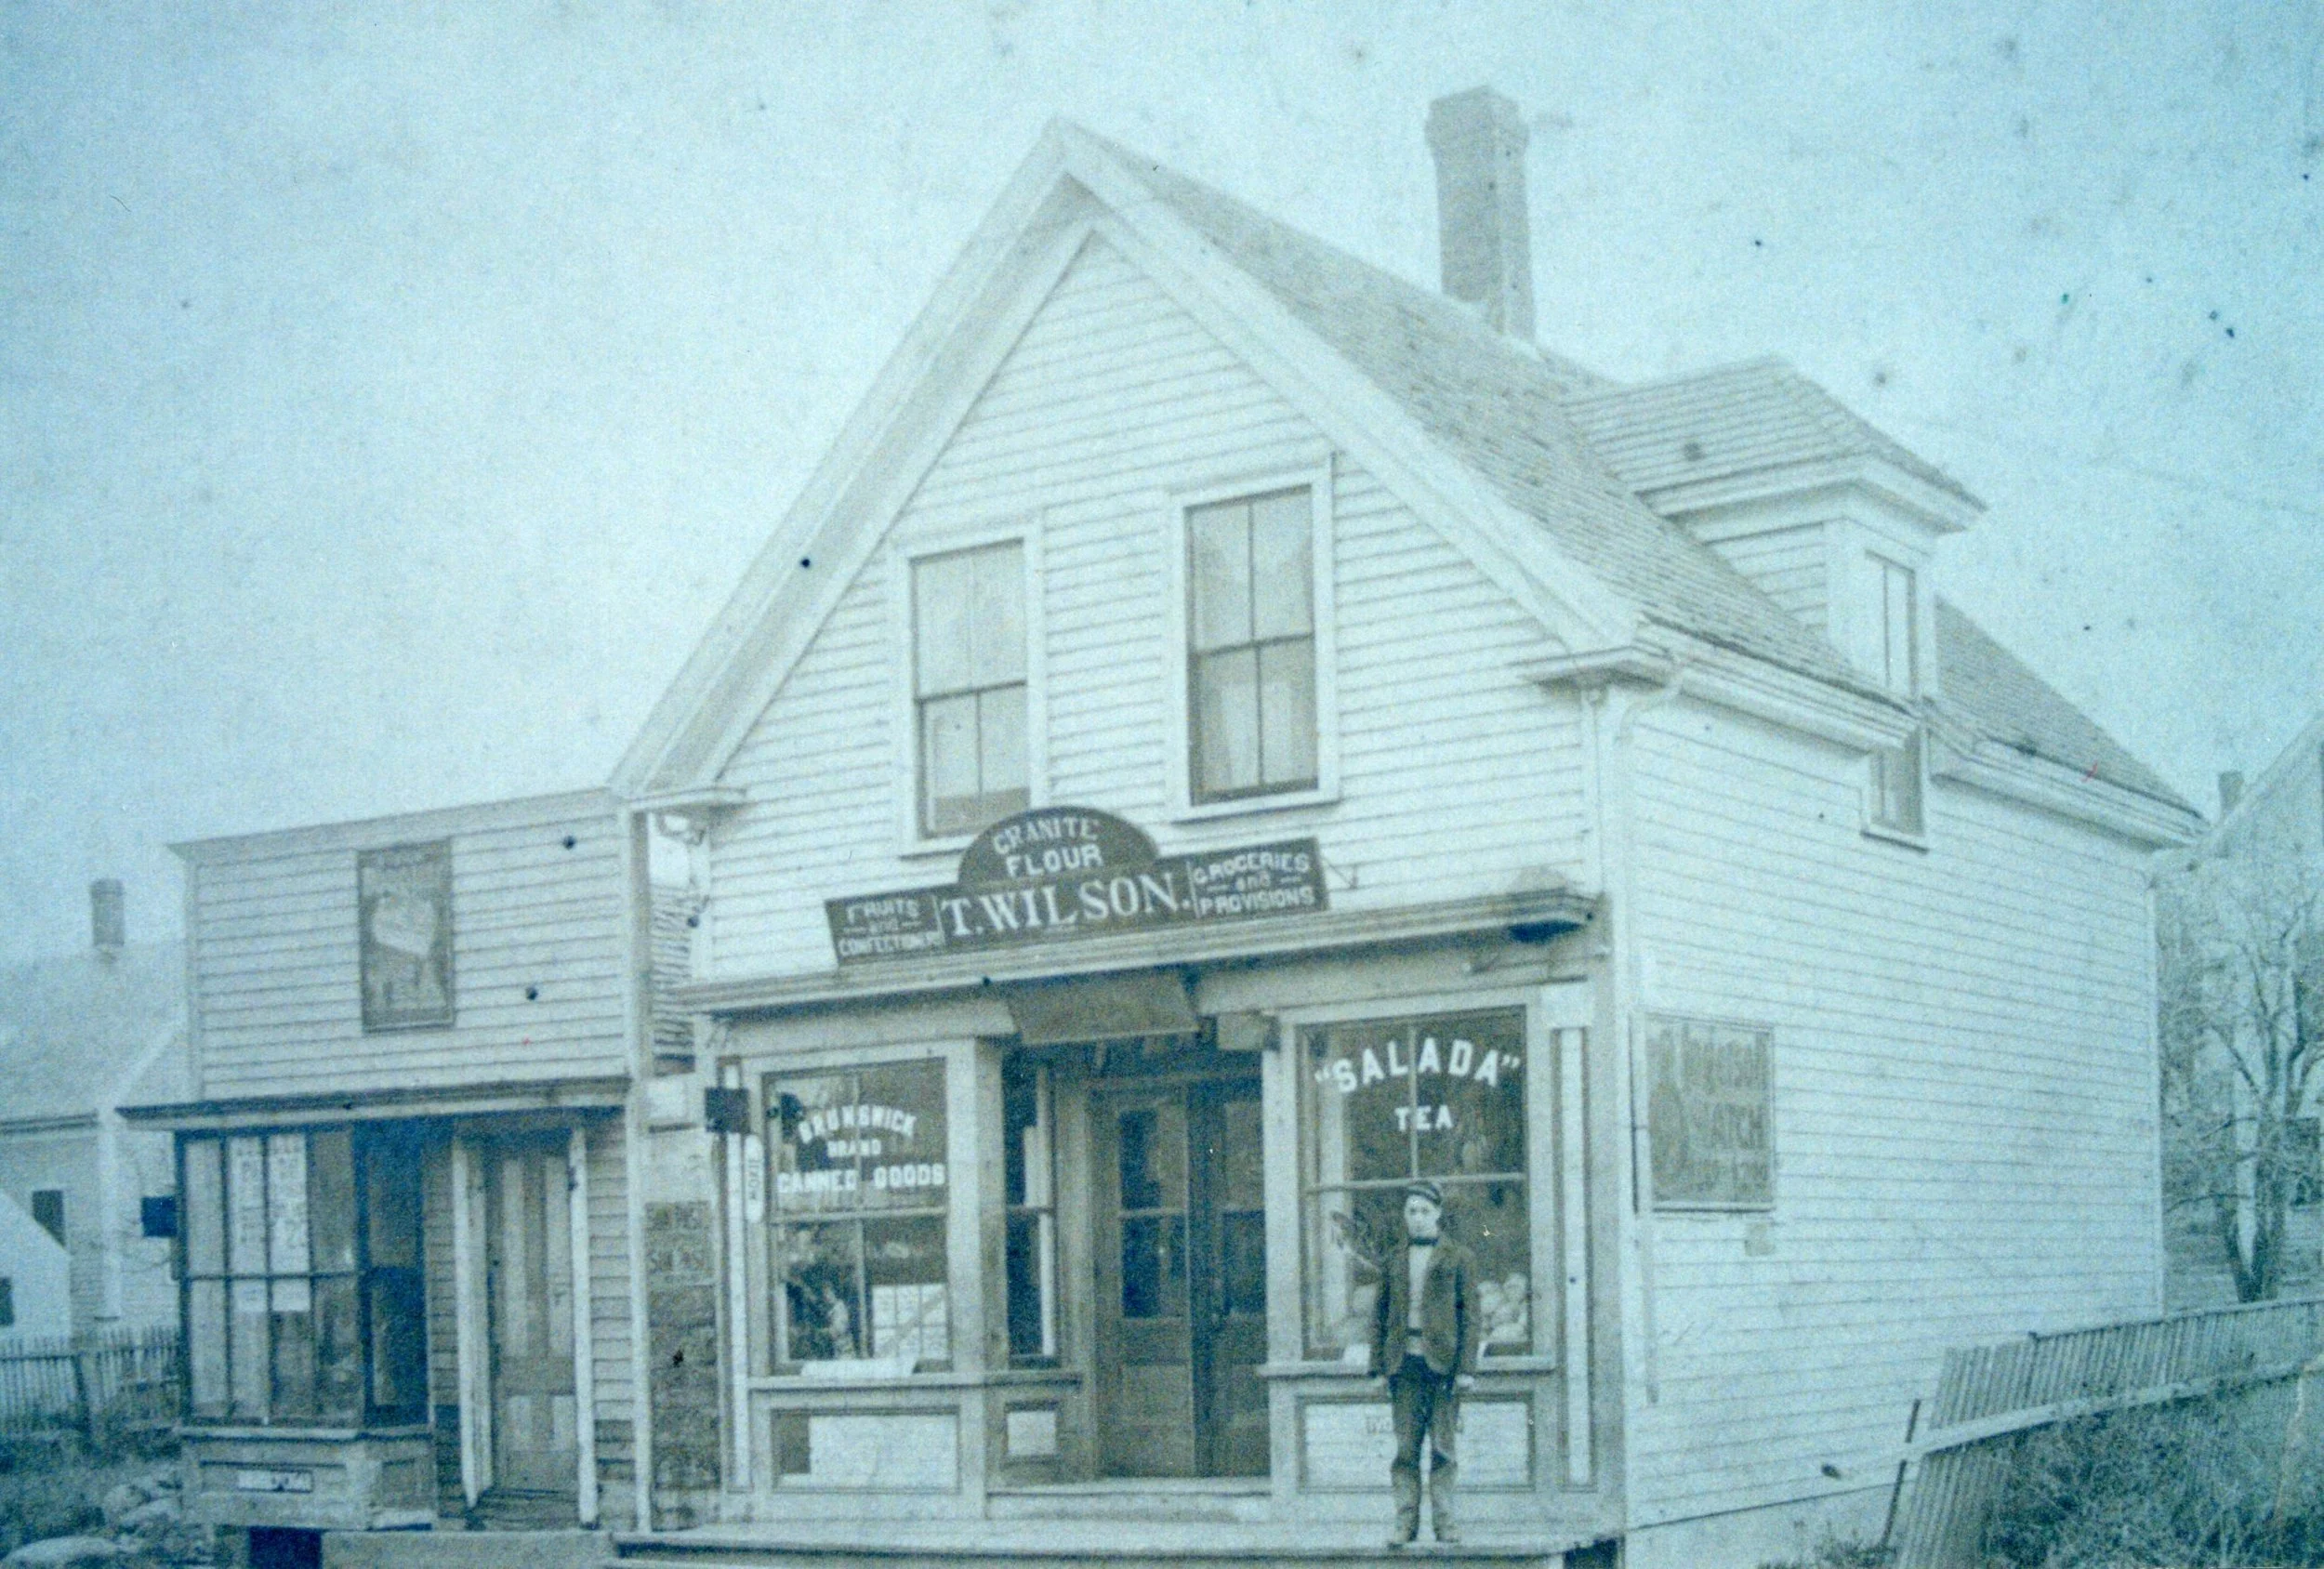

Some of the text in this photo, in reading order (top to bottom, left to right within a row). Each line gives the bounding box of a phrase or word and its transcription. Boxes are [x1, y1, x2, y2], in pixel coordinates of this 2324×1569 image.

[993, 817, 1100, 855] GRANITE
[1007, 843, 1104, 878] FLOUR
[1194, 851, 1310, 884] GROCERIES
[847, 899, 918, 926] FRUITS
[1199, 885, 1314, 916] PROVISIONS
[798, 1103, 918, 1145] BRUNSWICK
[1395, 1103, 1454, 1131] TEA
[827, 1139, 882, 1158] BRAND
[777, 1163, 946, 1194] CANNED GOODS
